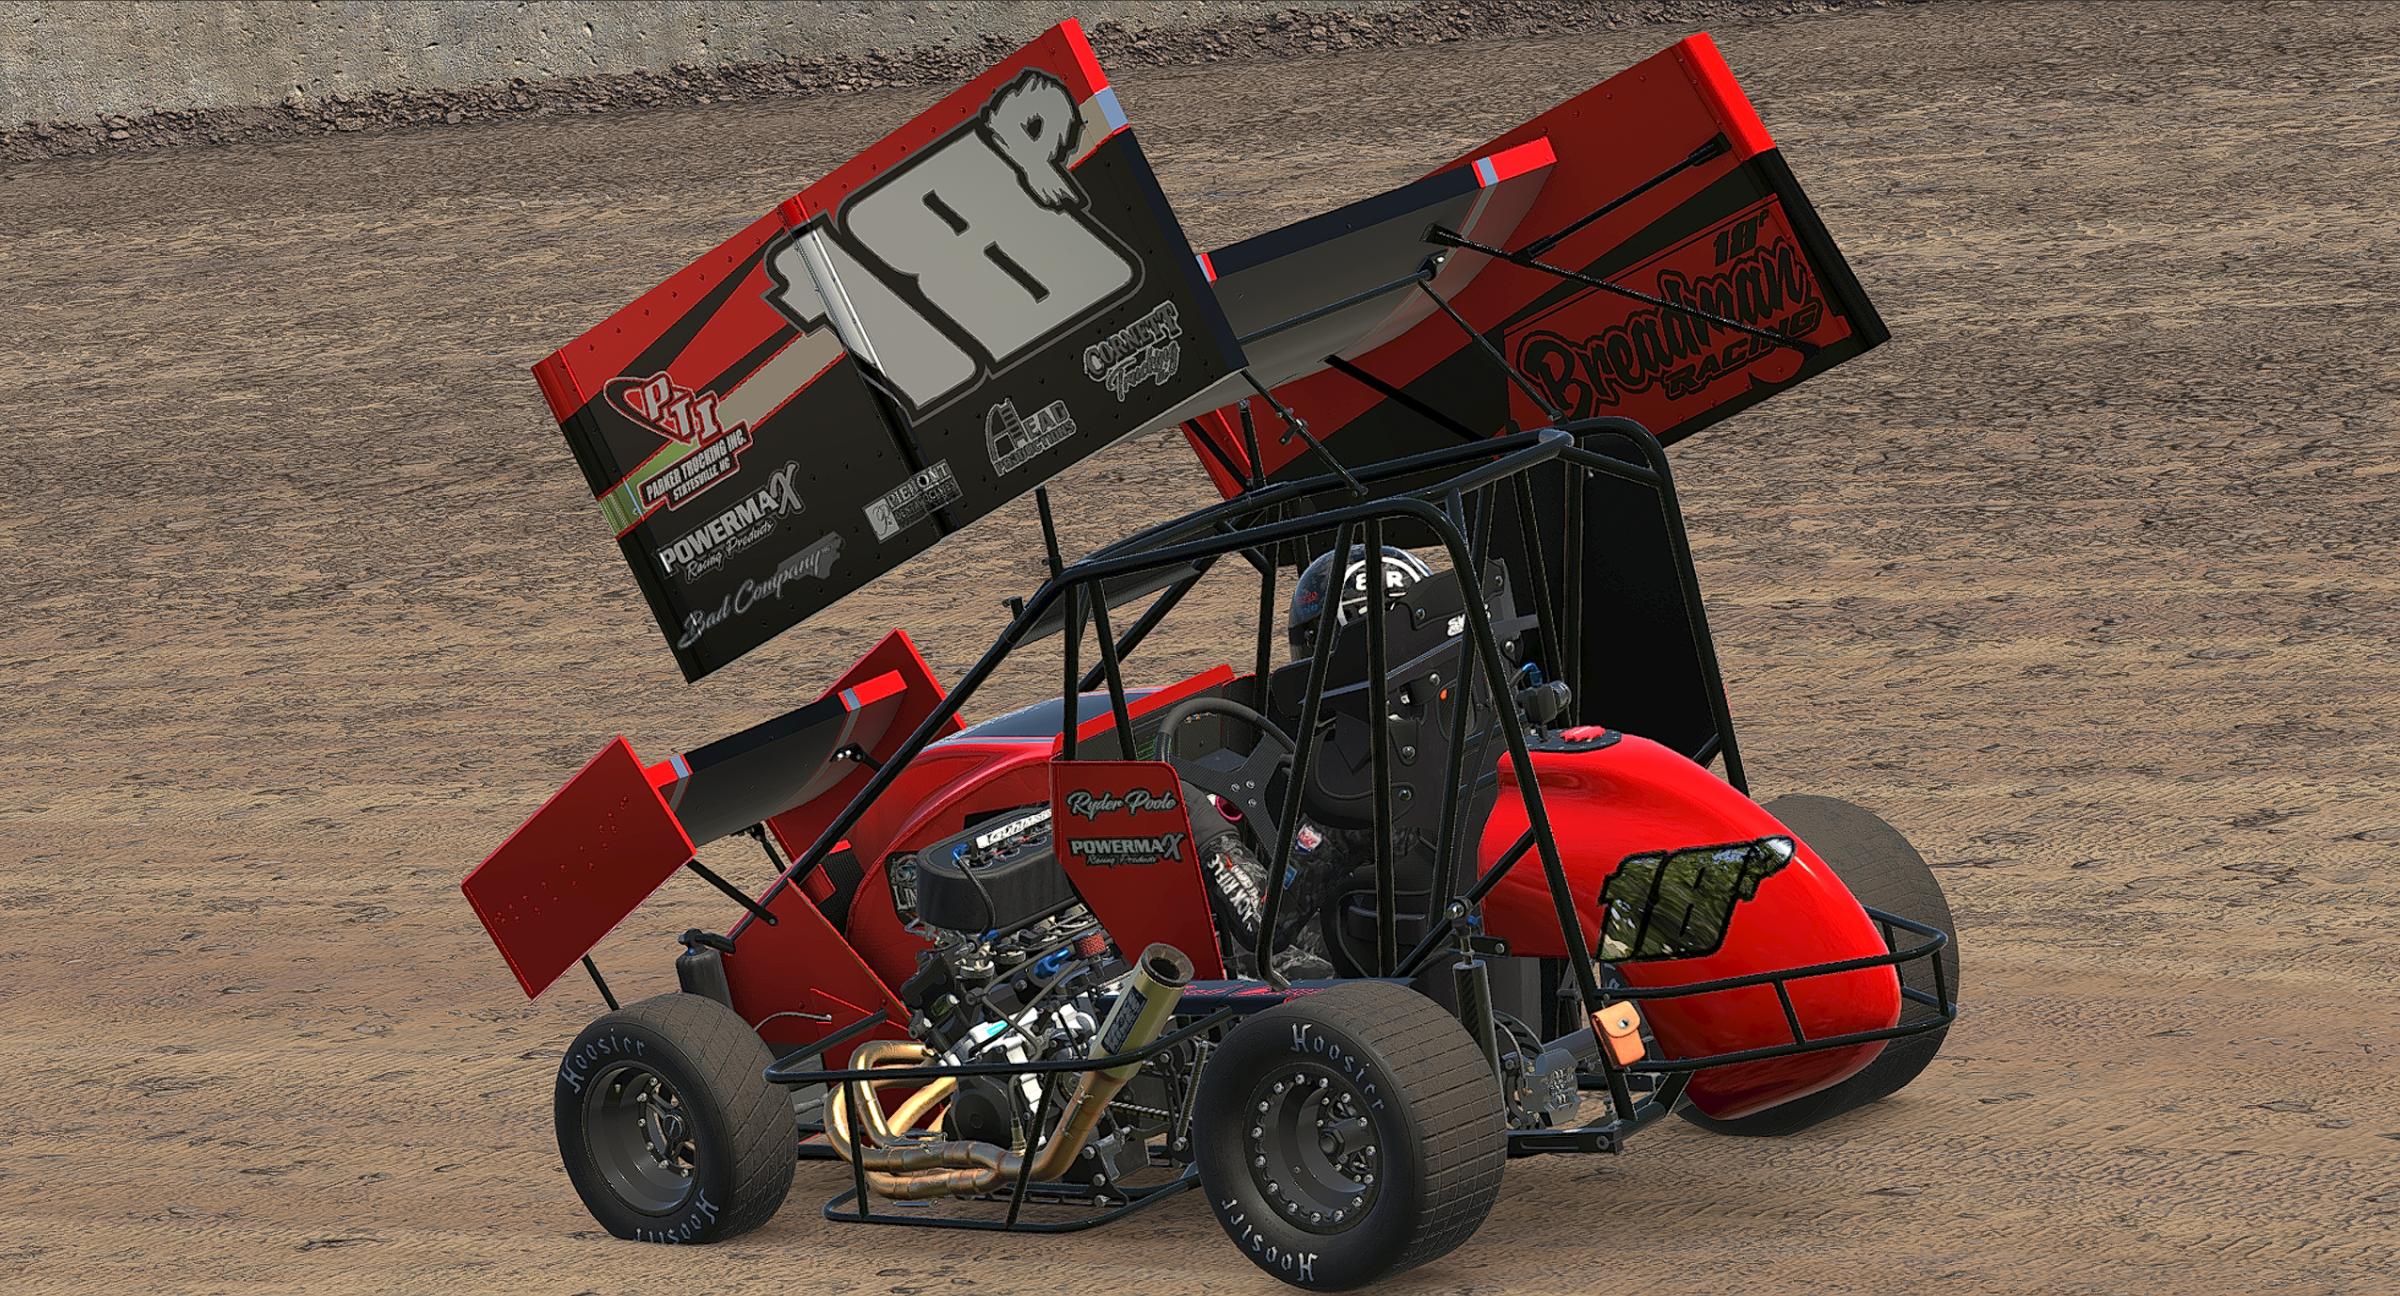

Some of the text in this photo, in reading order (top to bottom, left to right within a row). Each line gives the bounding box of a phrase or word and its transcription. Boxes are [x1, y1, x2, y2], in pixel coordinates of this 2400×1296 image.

[1084, 300, 1182, 381] CORNETT
[645, 470, 682, 501] PARKER
[680, 438, 728, 477] TRUCKING
[659, 463, 802, 573] POWERMAX
[686, 520, 774, 580] Racing Products
[734, 551, 821, 614] Company
[1066, 790, 1123, 820] Ryder
[1070, 833, 1184, 860] POWERMAX
[1290, 1022, 1385, 1111] Hoosier
